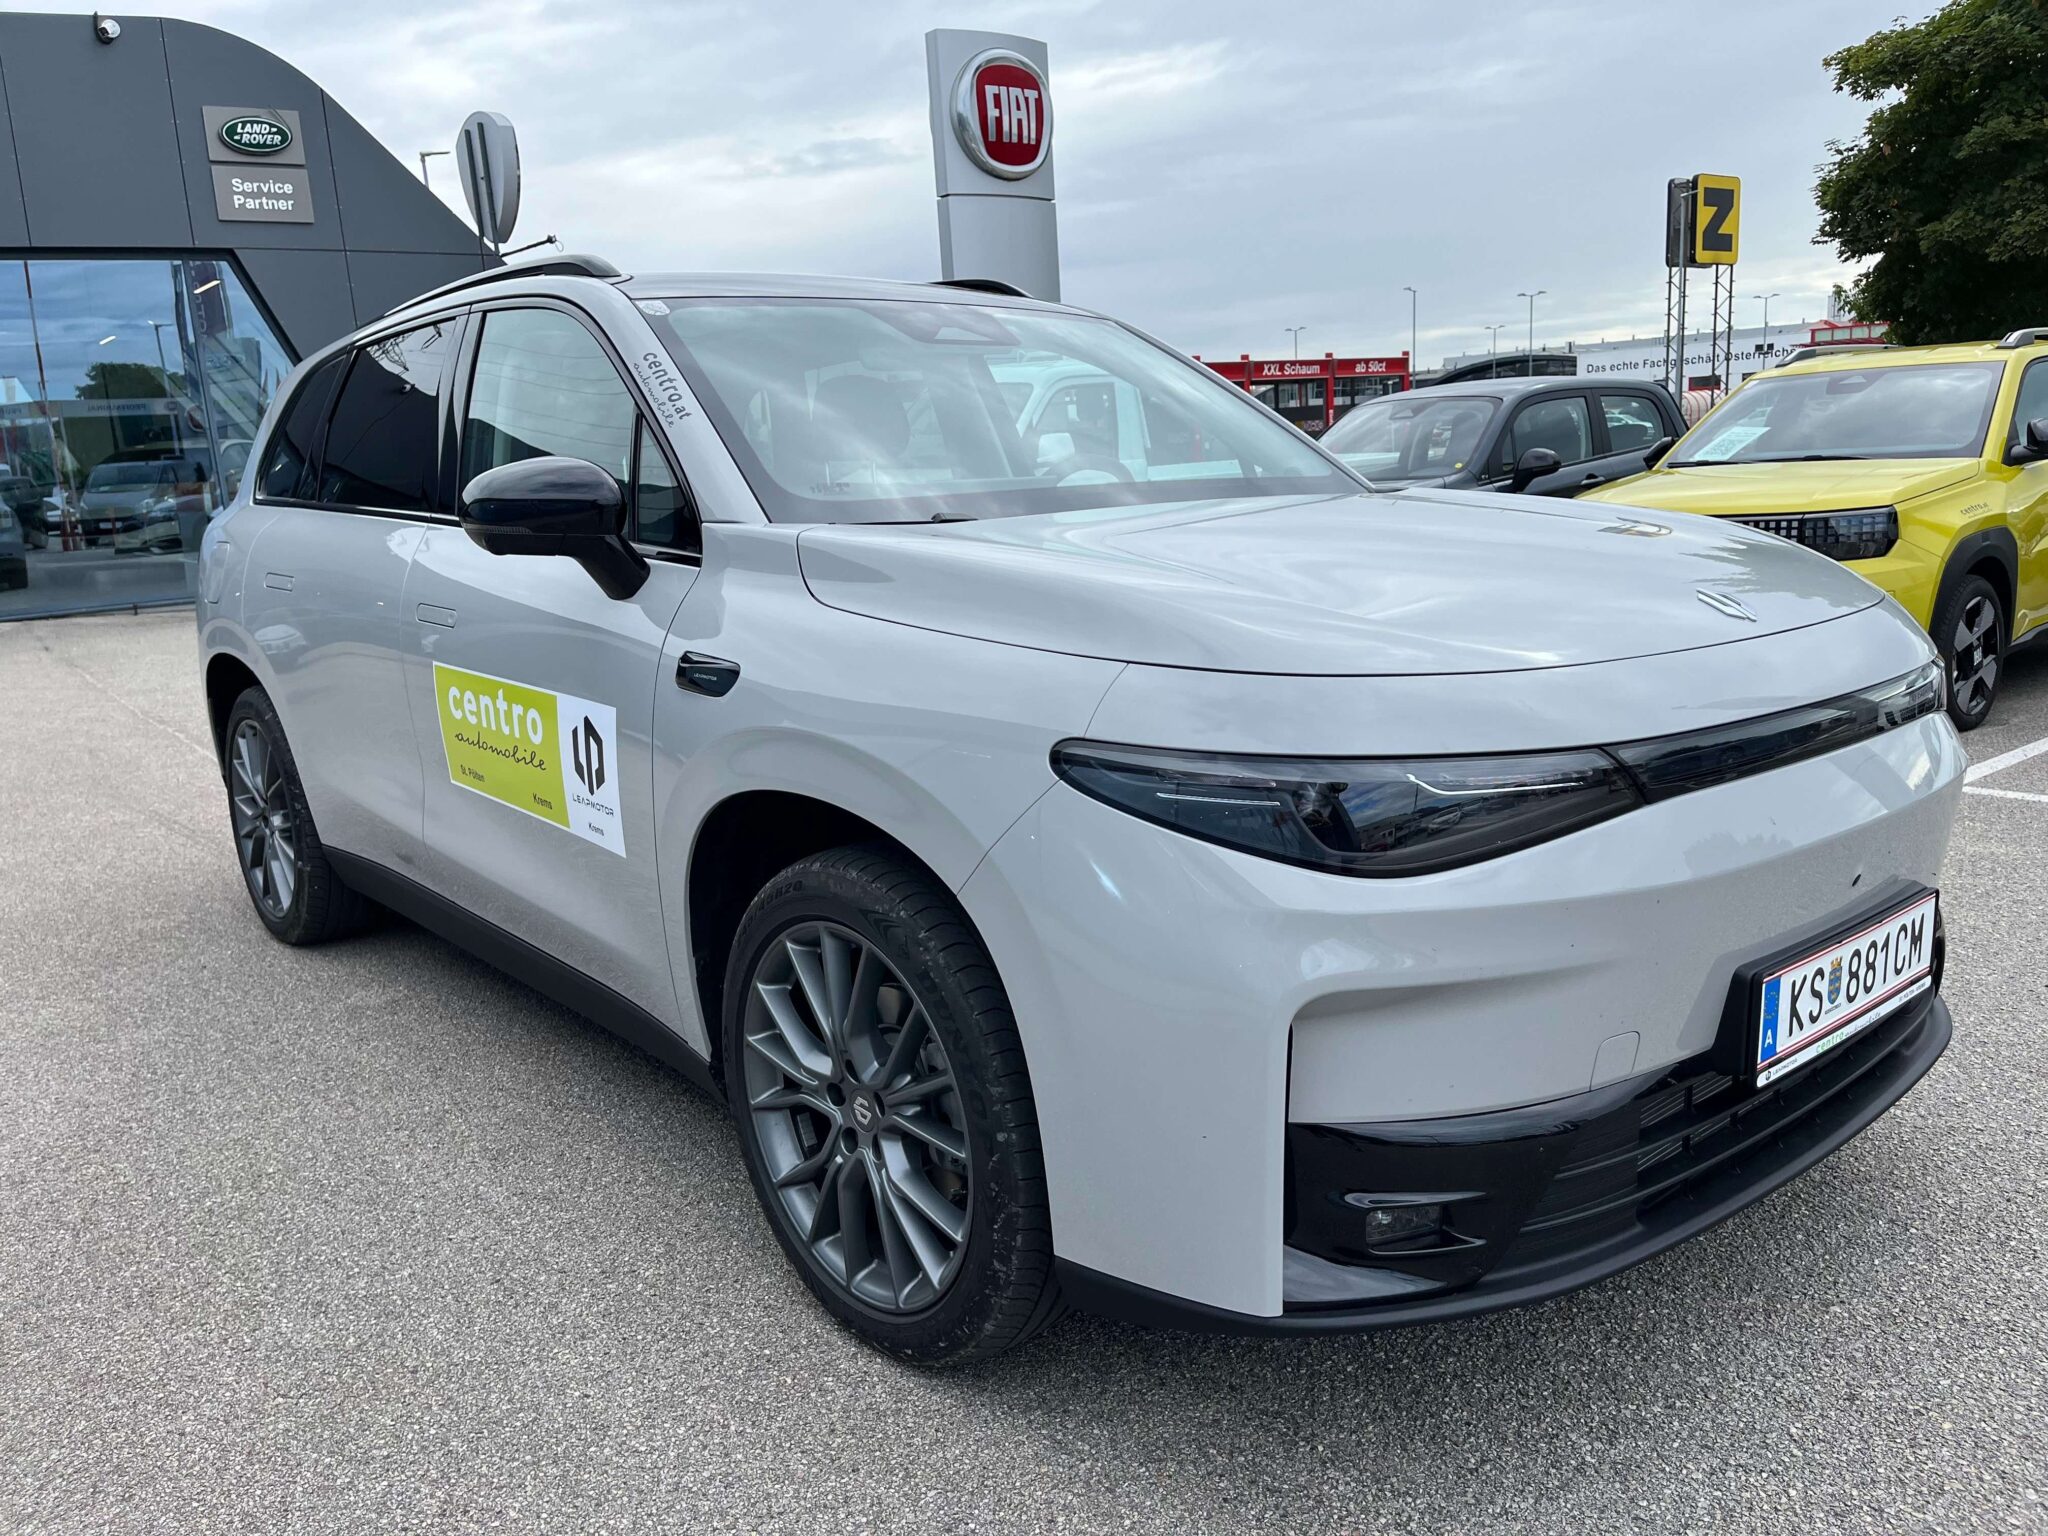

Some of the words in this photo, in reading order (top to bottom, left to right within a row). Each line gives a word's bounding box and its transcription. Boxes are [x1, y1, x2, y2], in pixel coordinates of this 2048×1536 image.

[984, 84, 1039, 145] FIAT
[236, 123, 270, 134] LAND
[241, 133, 282, 145] ROVER
[231, 178, 294, 194] Service
[233, 194, 294, 211] Partner
[1701, 186, 1735, 252] Z
[1262, 363, 1282, 376] XXL
[1283, 361, 1321, 376] Schaum
[1355, 361, 1366, 373] ab
[1367, 360, 1387, 373] 50ct
[1586, 363, 1607, 374] Das
[1609, 361, 1640, 372] echte
[1642, 353, 1720, 369] Fachgschät
[643, 352, 693, 420] centro.at
[448, 686, 543, 745] centro
[455, 731, 547, 771] automobile
[532, 792, 553, 810] Krems
[572, 793, 615, 817] LEAPMOTOR
[588, 822, 605, 837] Krems
[1788, 966, 1825, 1037] KS
[1845, 912, 1925, 1004] 881CM
[1764, 1028, 1774, 1049] A
[1815, 1031, 1845, 1053] centro
